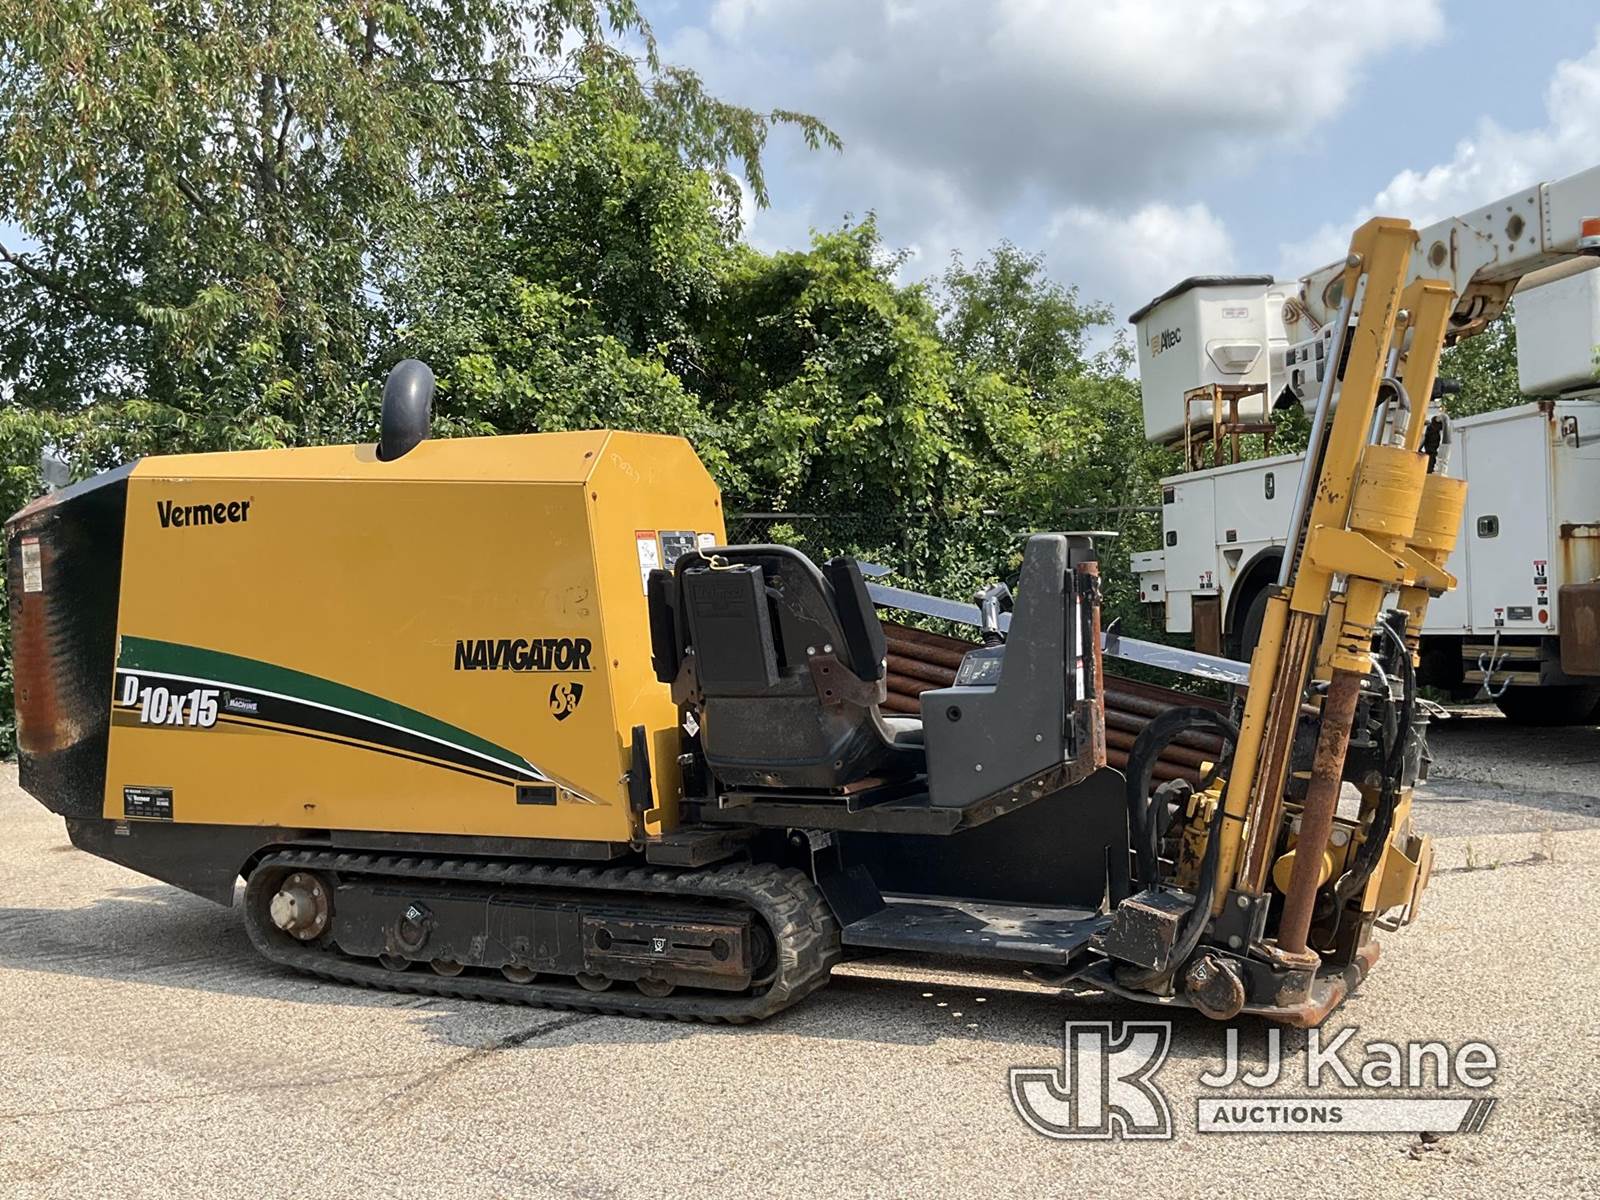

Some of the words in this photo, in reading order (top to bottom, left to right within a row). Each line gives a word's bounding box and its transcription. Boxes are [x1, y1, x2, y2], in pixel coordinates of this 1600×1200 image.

[1160, 327, 1182, 352] Altec
[157, 500, 250, 528] Vermeer
[454, 637, 593, 671] NAVIGATOR
